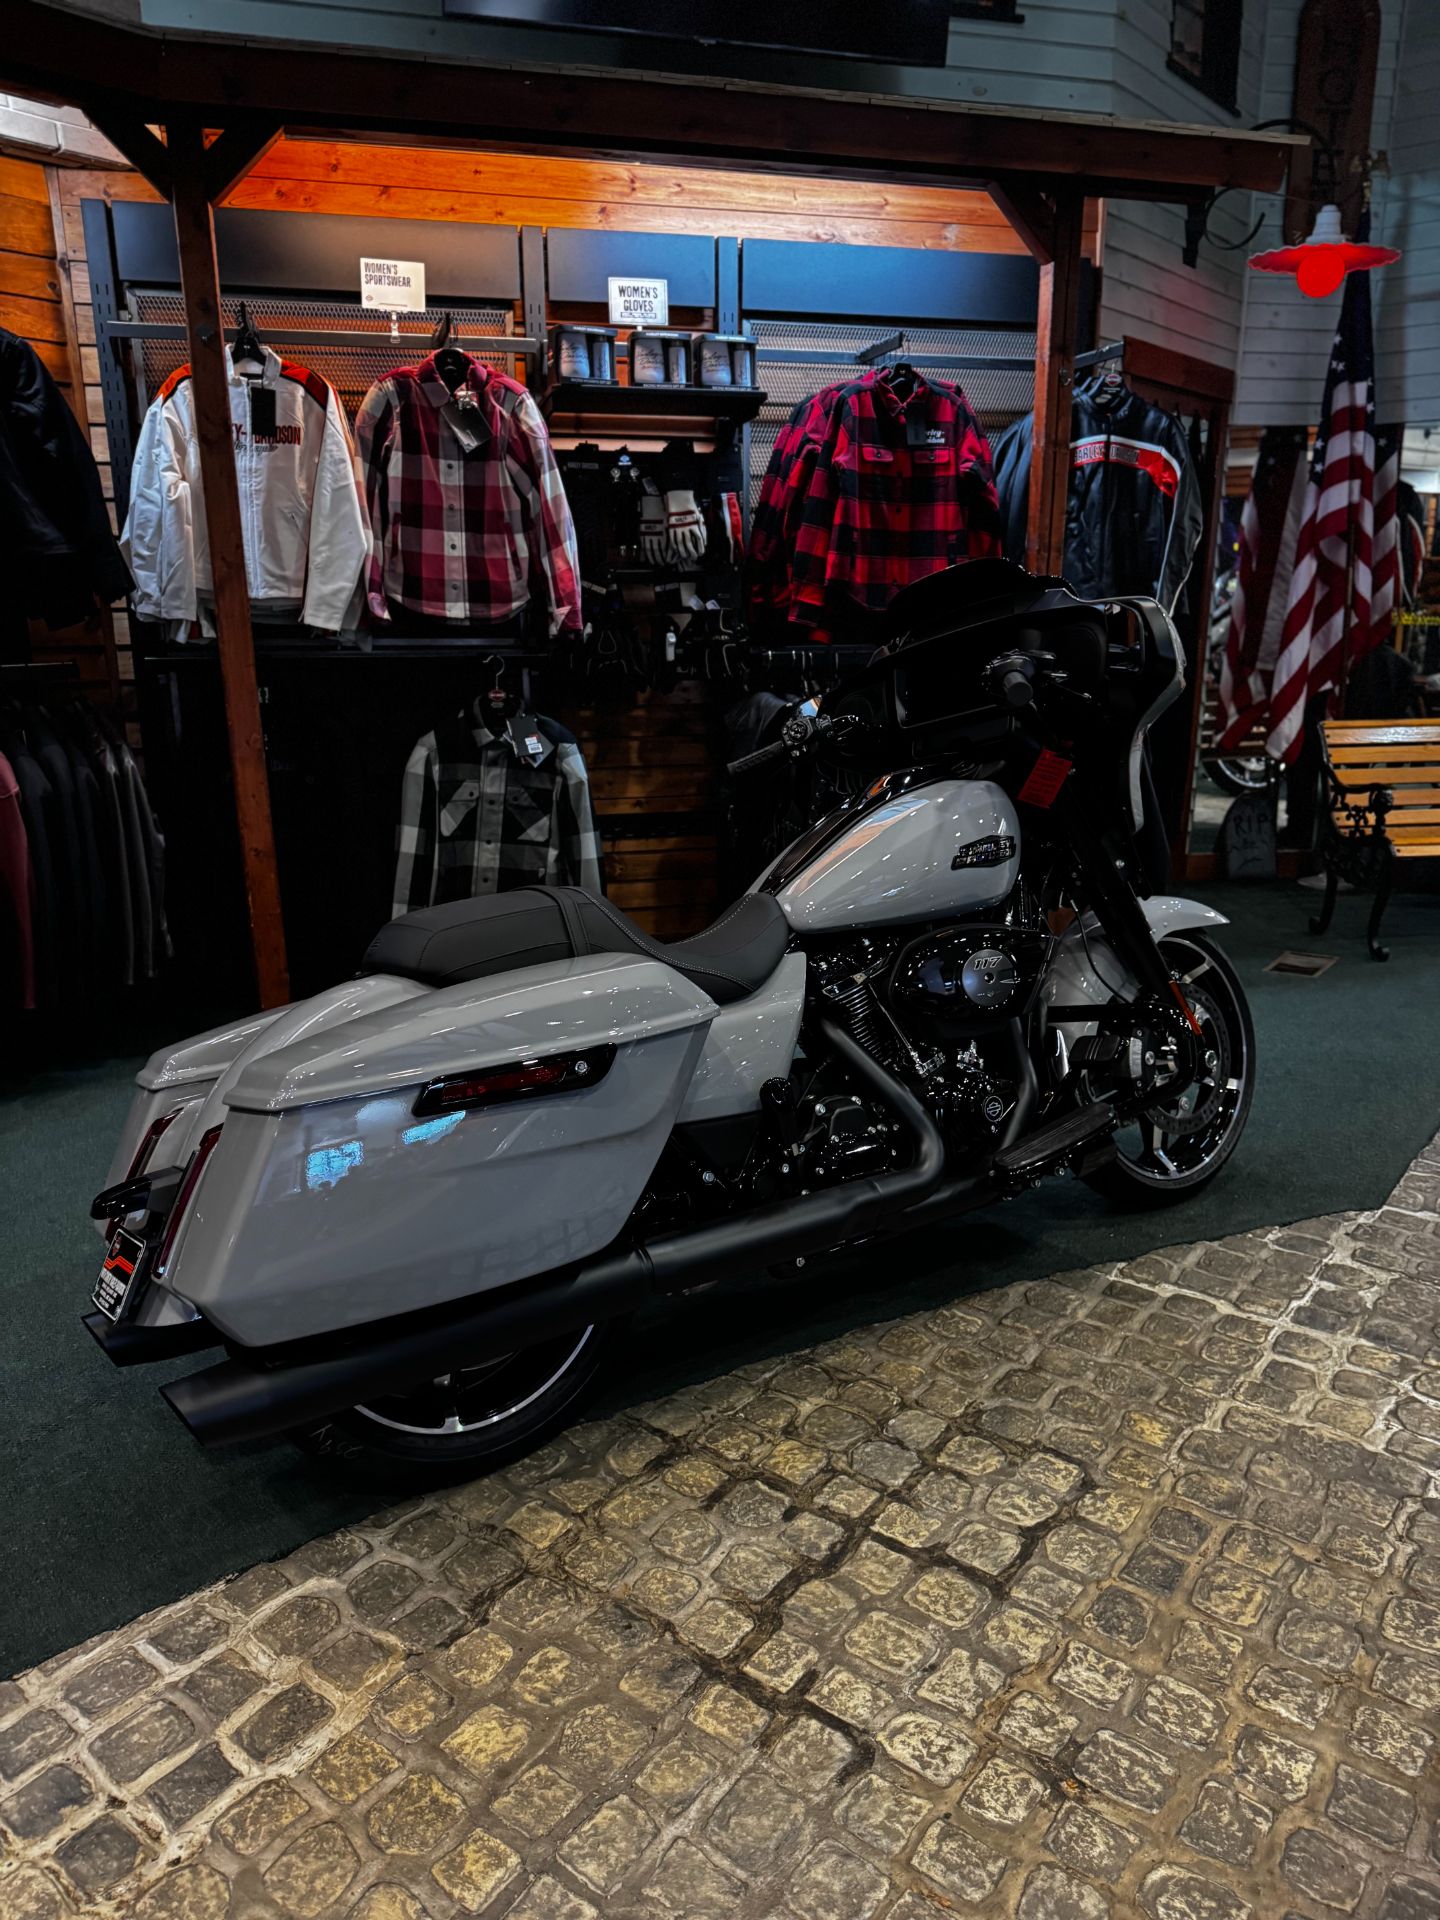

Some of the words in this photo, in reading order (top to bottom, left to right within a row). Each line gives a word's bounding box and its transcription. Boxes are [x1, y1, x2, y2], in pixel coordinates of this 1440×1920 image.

[364, 262, 398, 275] WOMEN'S
[364, 274, 411, 288] SPORTSWEAR
[618, 284, 658, 299] WOMEN'S
[623, 299, 654, 312] GLOVES
[973, 955, 1003, 971] 117
